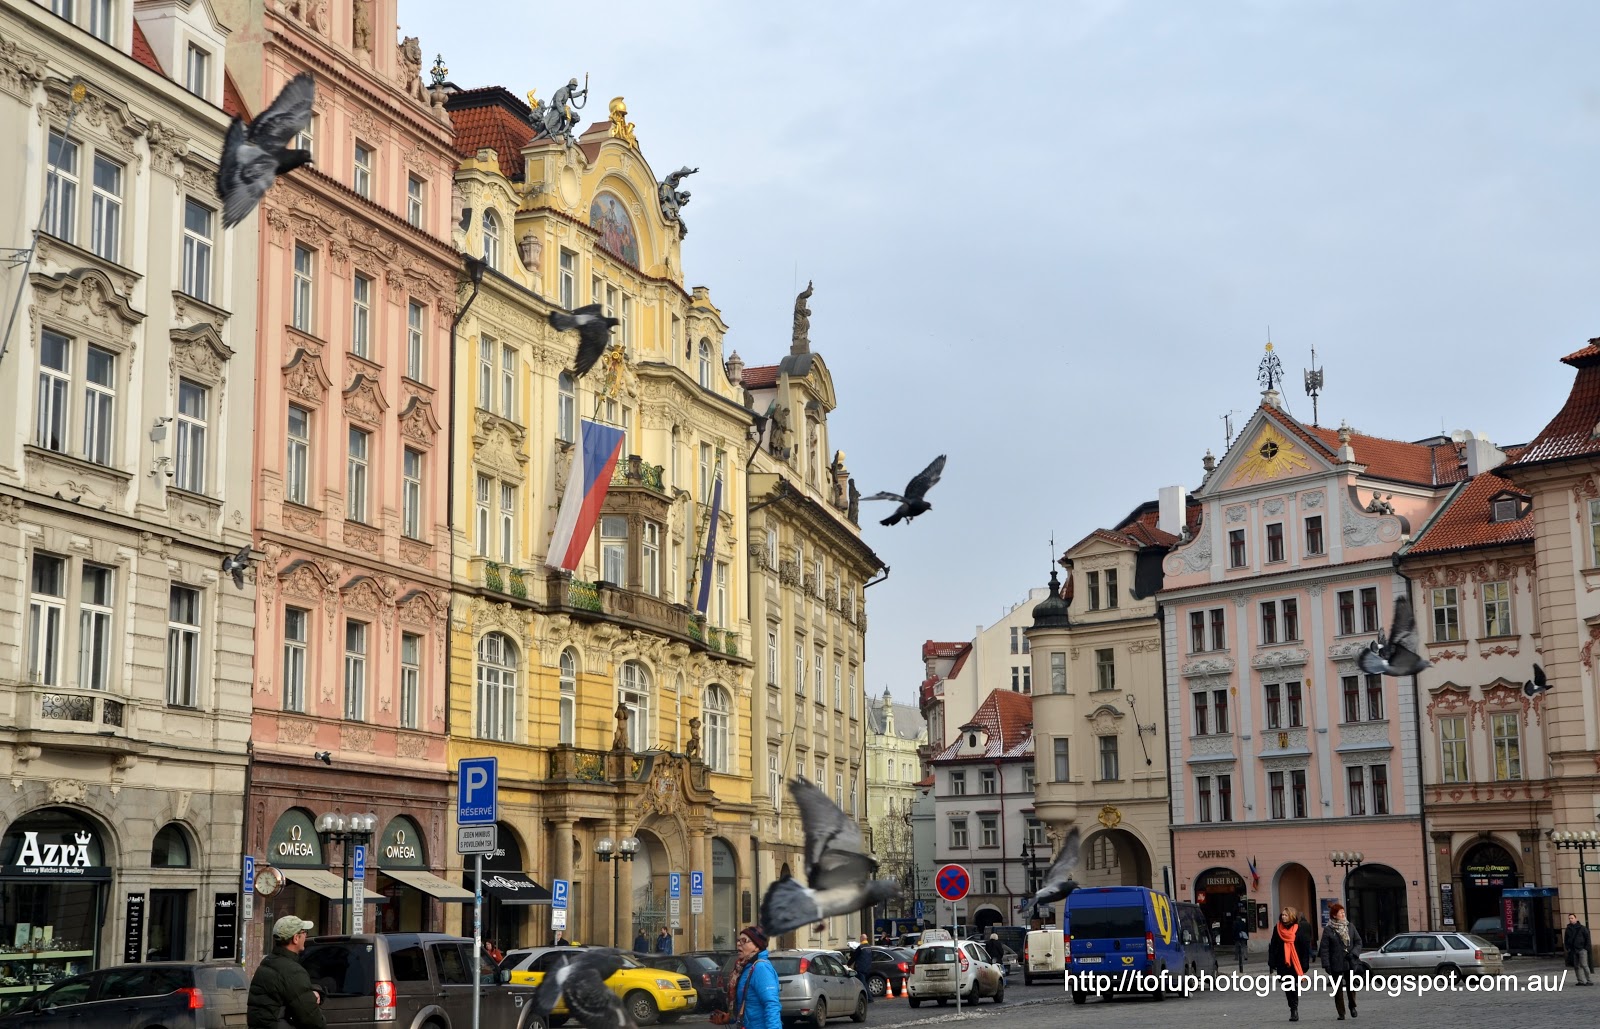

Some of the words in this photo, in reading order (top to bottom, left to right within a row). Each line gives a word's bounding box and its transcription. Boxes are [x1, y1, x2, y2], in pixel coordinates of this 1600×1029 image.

[466, 766, 488, 803] P
[460, 805, 493, 817] RÉSERVÉ
[475, 830, 491, 838] MINIBUS
[279, 842, 314, 857] OMEGA
[386, 845, 416, 859] OMEGA
[1197, 849, 1236, 859] CAFFREY'S
[23, 866, 39, 874] Luxury
[64, 867, 84, 875] Jewellery
